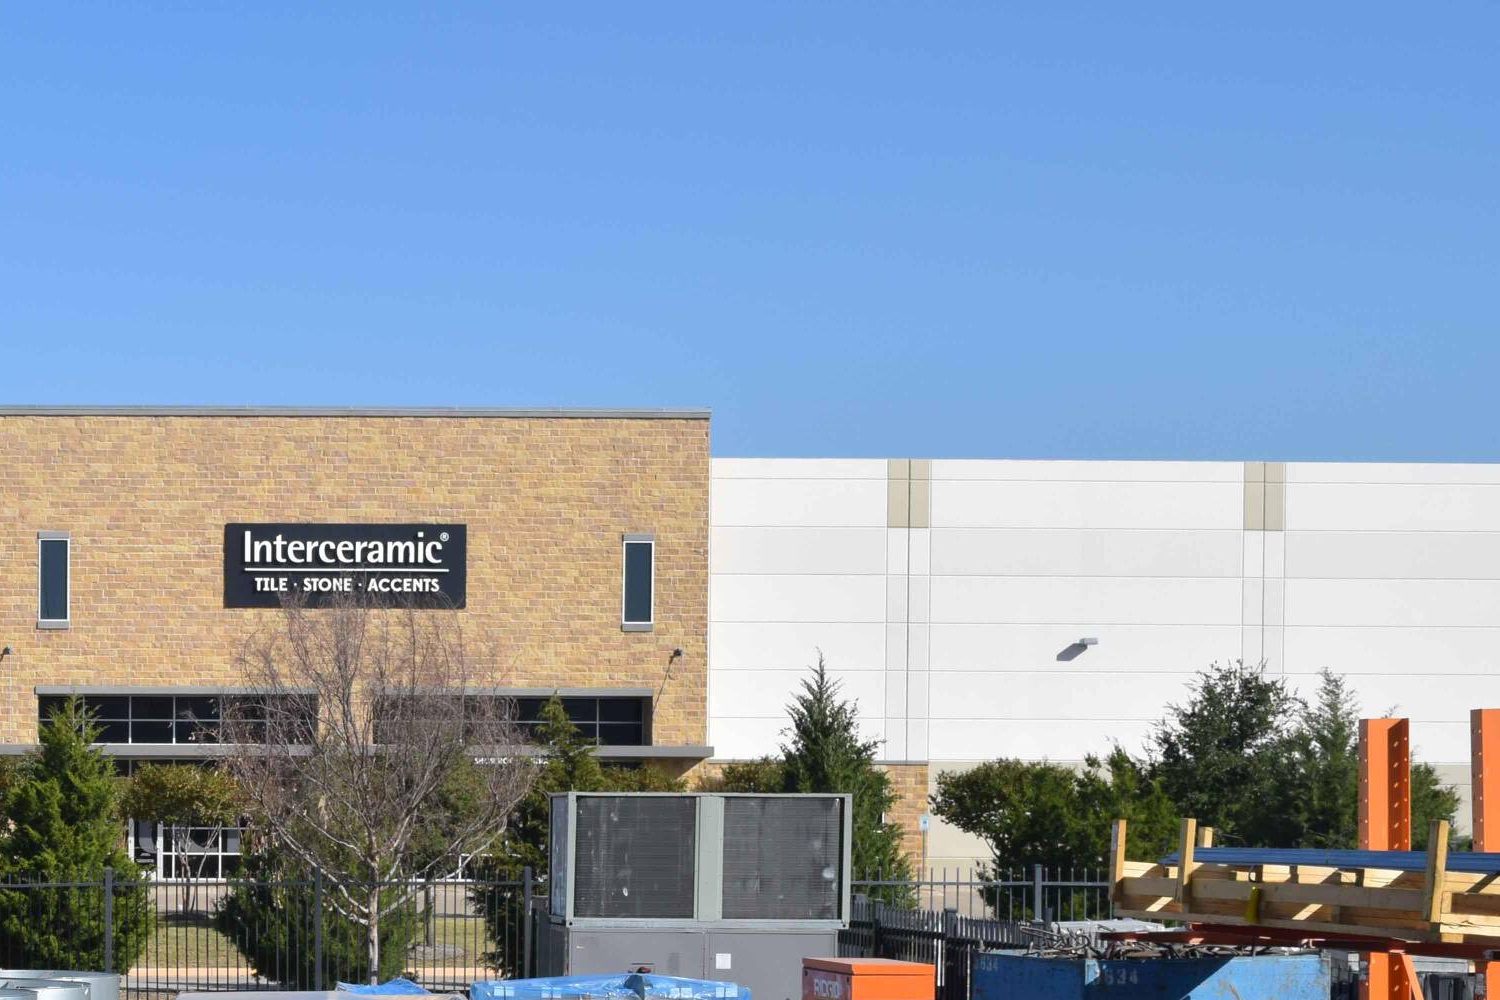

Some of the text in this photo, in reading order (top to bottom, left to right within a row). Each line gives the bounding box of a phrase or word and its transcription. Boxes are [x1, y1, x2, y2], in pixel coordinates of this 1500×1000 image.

[255, 577, 440, 593] TILE STONE ACCENTS
